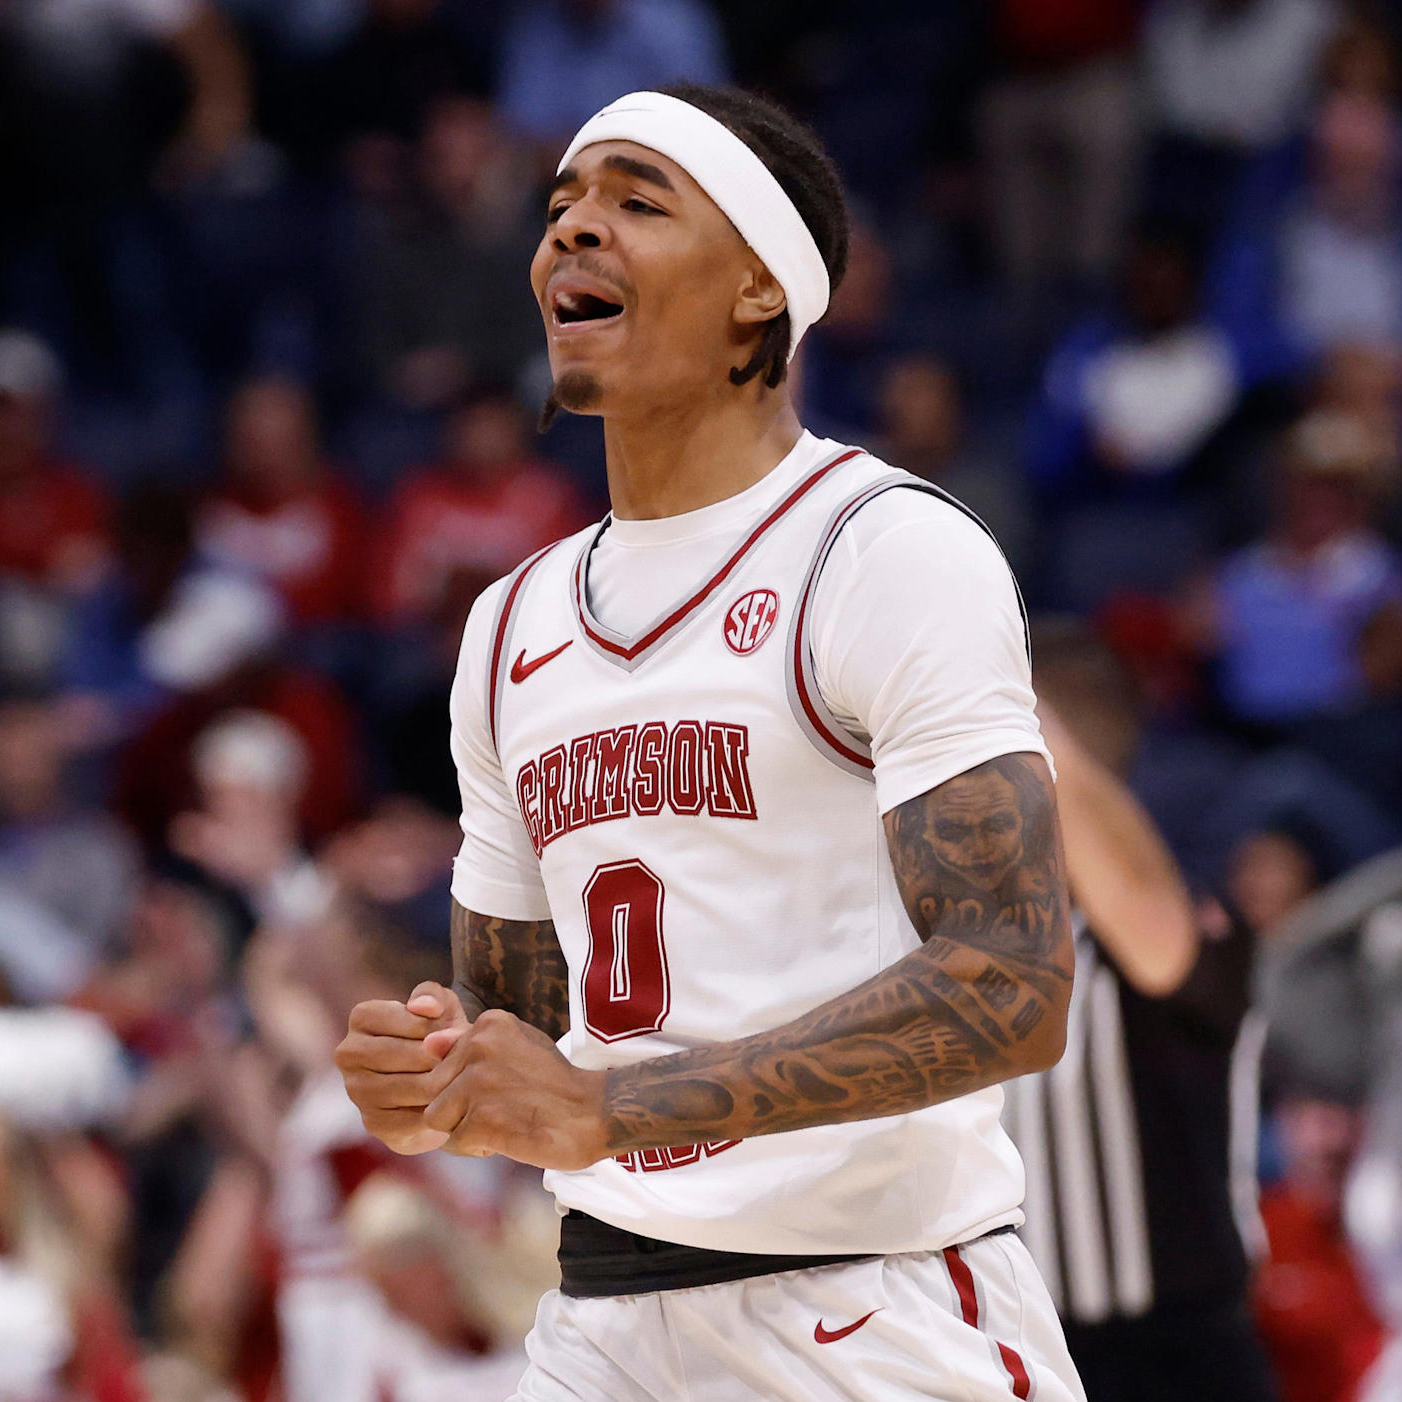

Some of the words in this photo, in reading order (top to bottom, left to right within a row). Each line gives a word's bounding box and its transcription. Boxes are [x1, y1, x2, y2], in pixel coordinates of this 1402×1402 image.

[725, 591, 778, 652] SEC
[516, 720, 758, 859] CRIMSON
[581, 858, 671, 1044] 0
